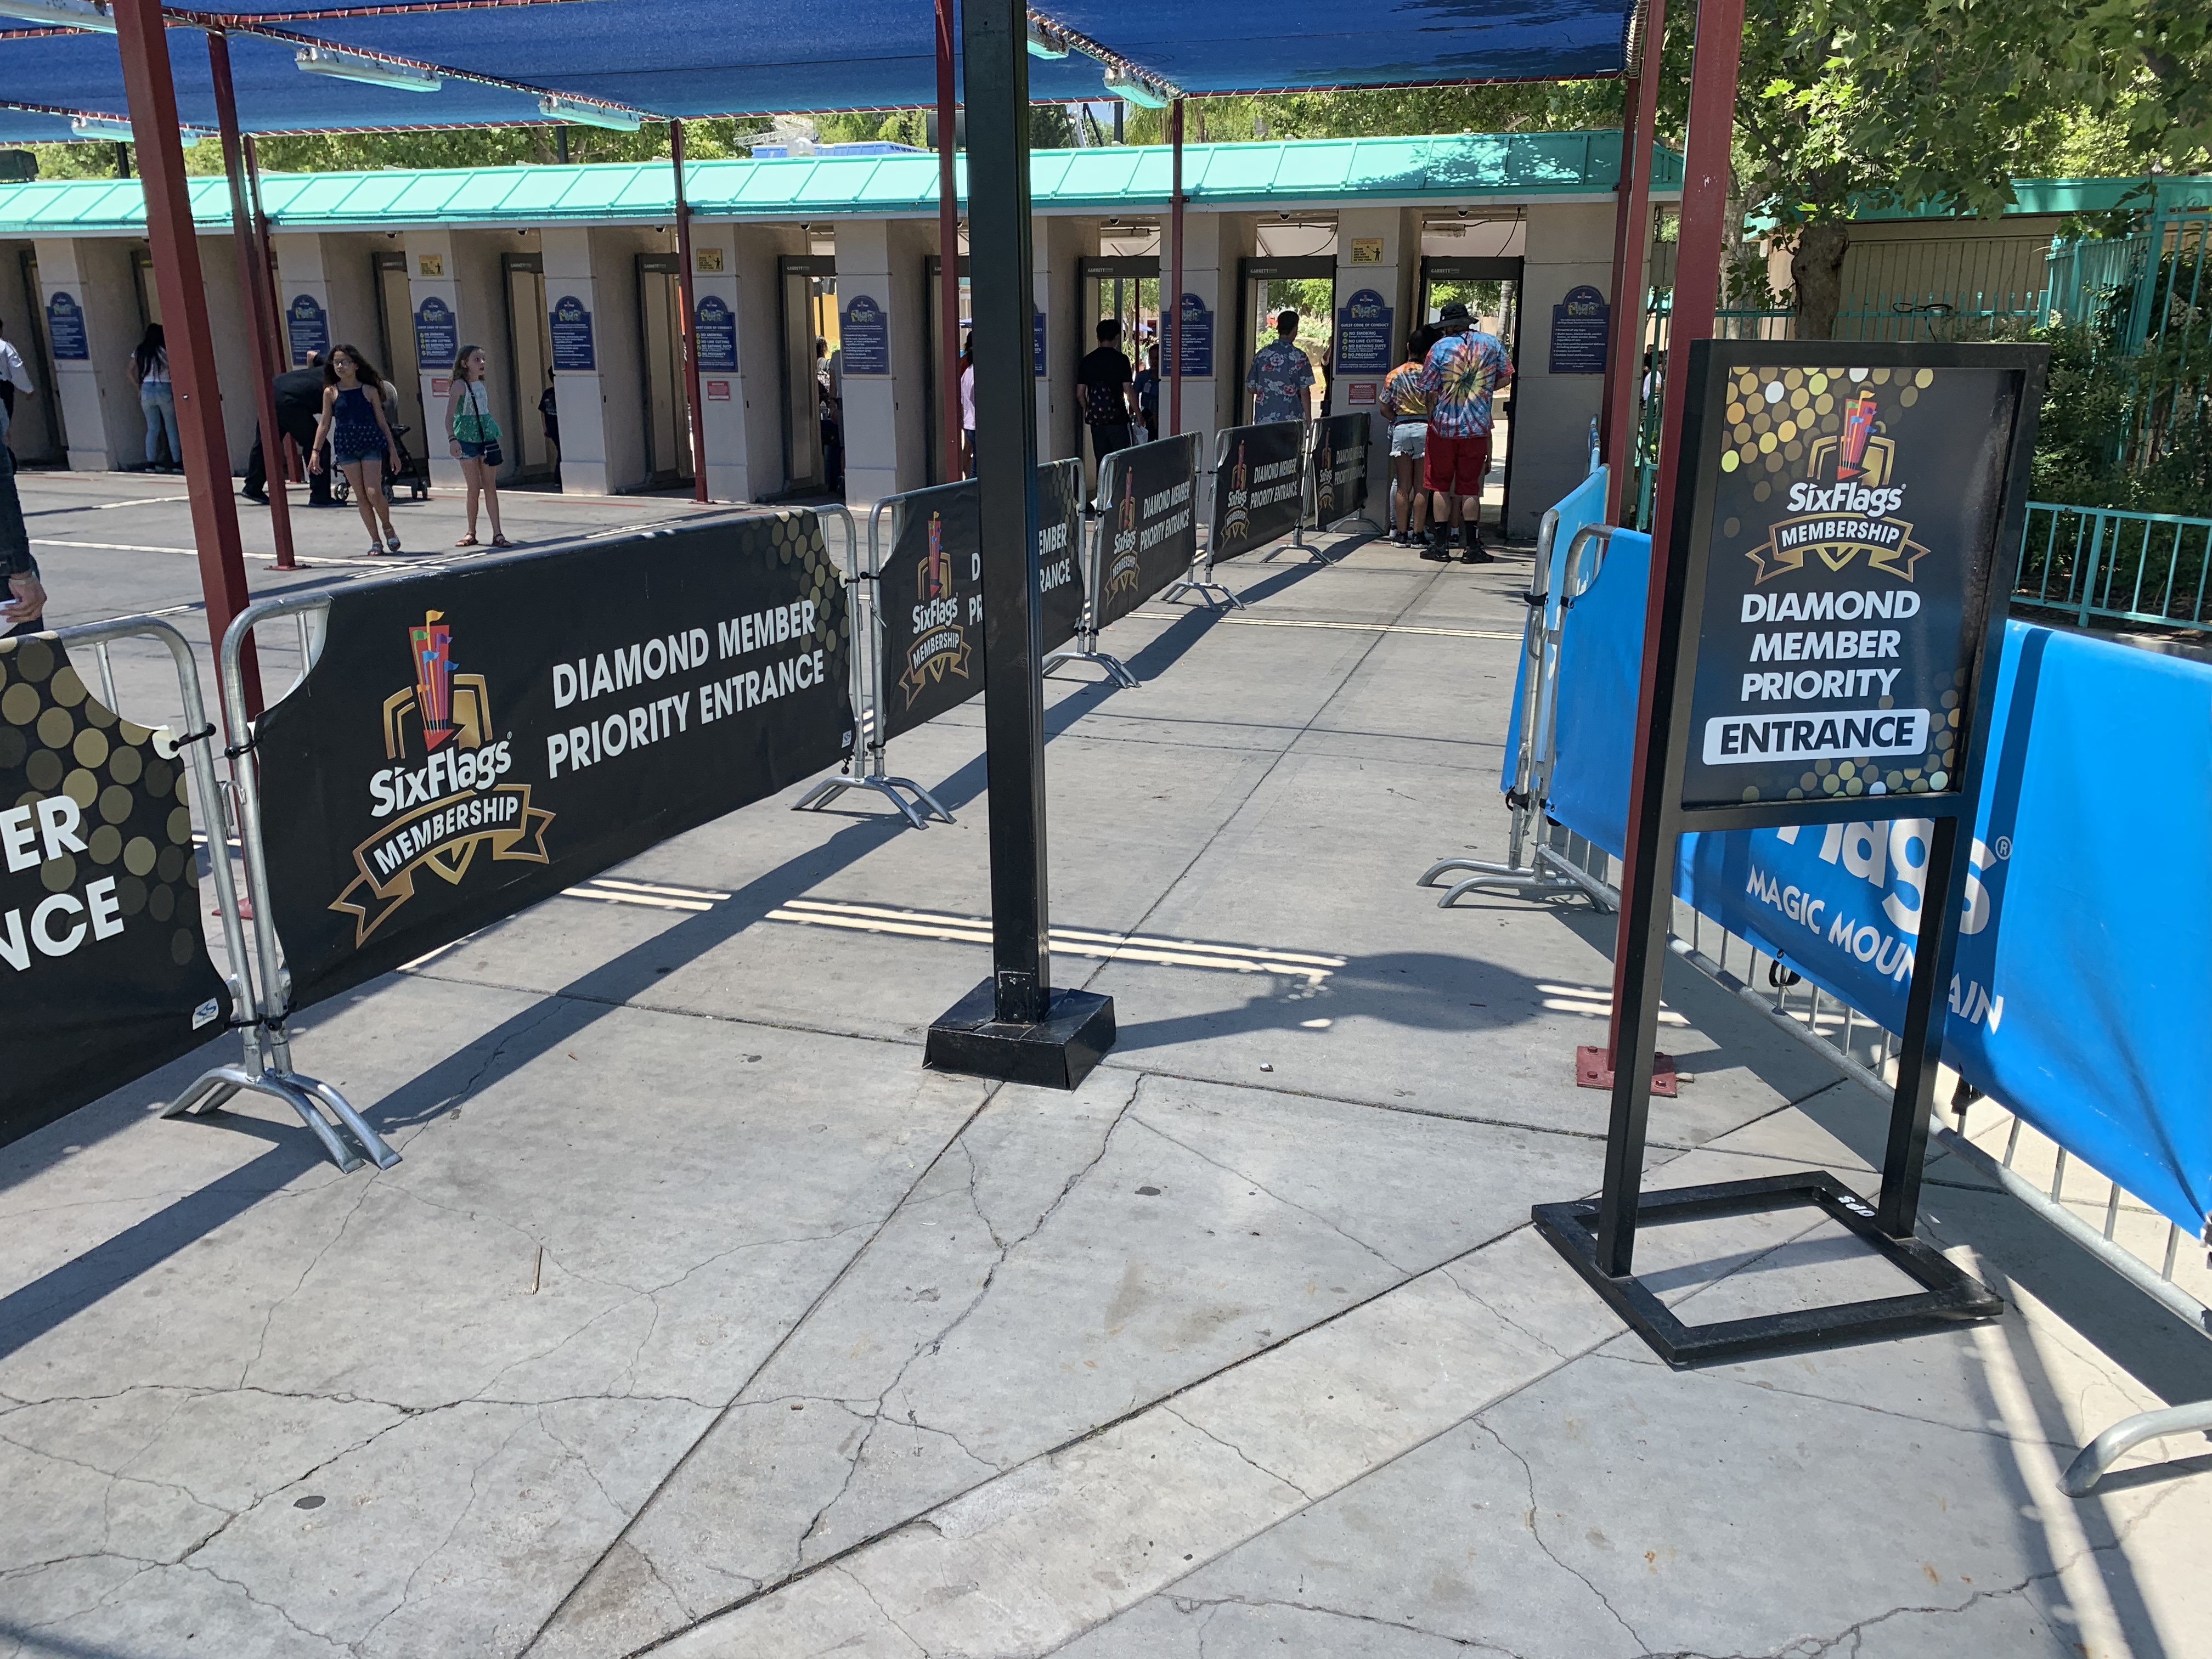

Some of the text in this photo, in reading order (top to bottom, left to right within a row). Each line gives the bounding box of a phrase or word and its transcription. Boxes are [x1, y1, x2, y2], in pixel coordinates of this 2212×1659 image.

[1254, 458, 1297, 484] DIAMOND MEMBER
[1143, 481, 1190, 520] DIAMOND MEMBER
[1250, 487, 1274, 510] PRIORITY
[1273, 480, 1297, 503] ENTRANCE
[1786, 482, 1903, 517] SixFlags
[1039, 522, 1068, 556] EMBER
[1140, 508, 1190, 552] PRIORITY ENTRANCE
[1781, 520, 1900, 547] MEMBERSHIP
[1112, 555, 1136, 580] MEMBERSHIP
[912, 596, 958, 634] SixFlags
[1740, 590, 1921, 623] DIAMOND
[552, 599, 816, 709] DIAMOND MEMBER
[912, 632, 960, 669] MEMBERSHIP
[1749, 629, 1900, 662] MEMBER
[1741, 668, 1901, 702] PRIORITY
[546, 648, 825, 780] PRIORITY ENTRANCE
[1720, 715, 1916, 755] ENTRANCE
[369, 739, 512, 818] SixFlags
[373, 796, 519, 876] MEMBERSHIP
[1746, 864, 2004, 1035] MAGIC MOUNAIN
